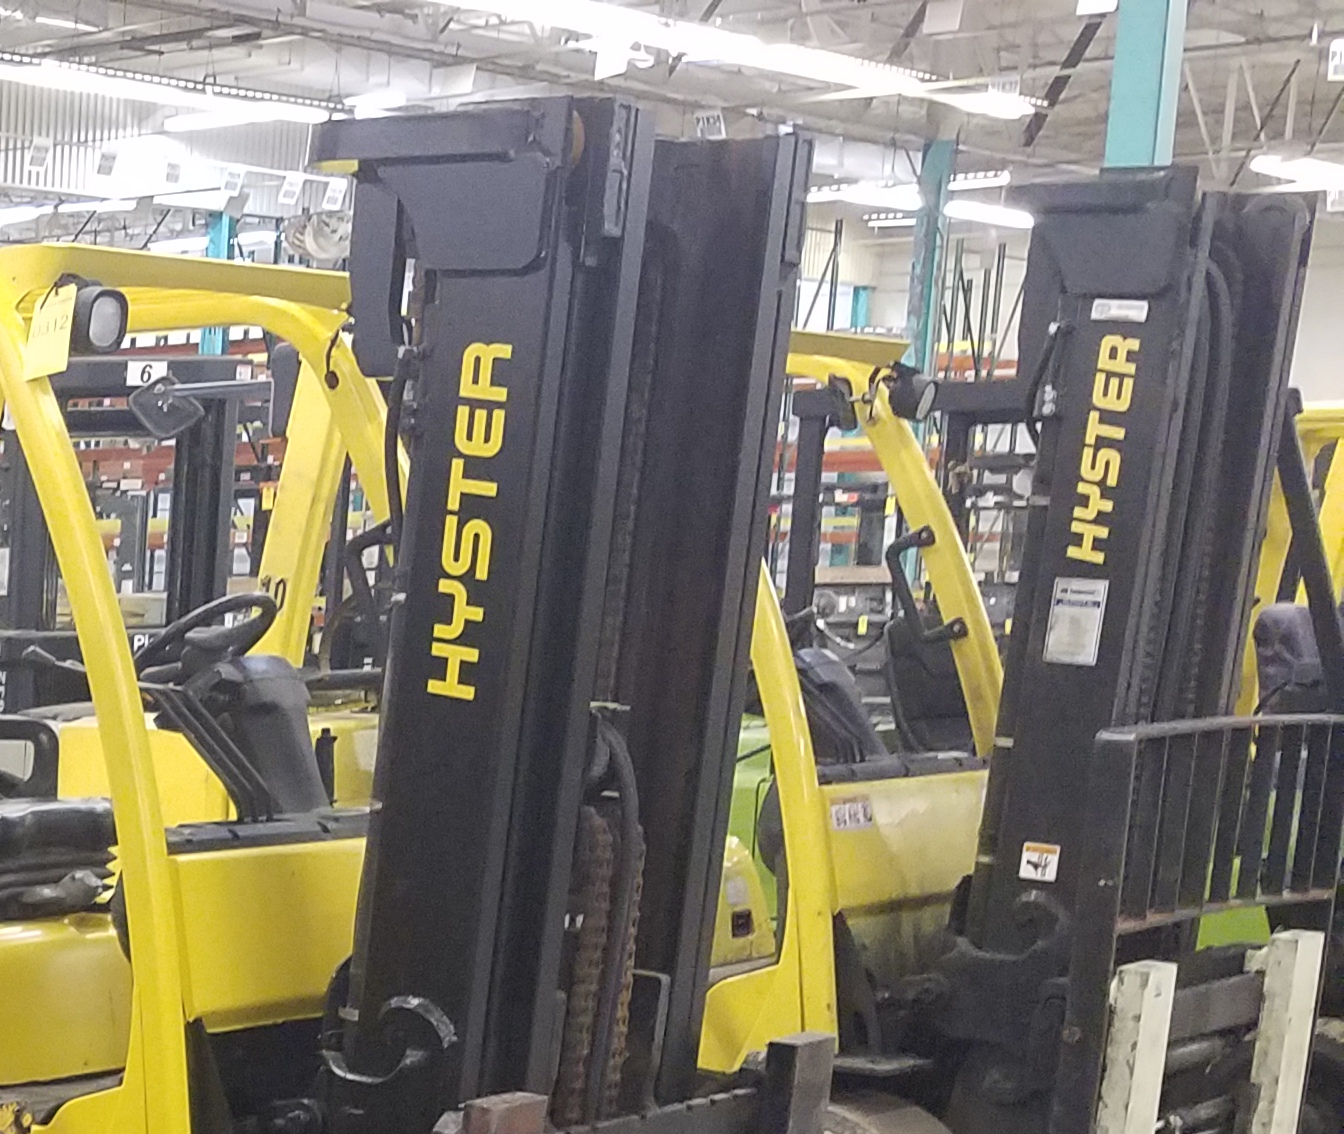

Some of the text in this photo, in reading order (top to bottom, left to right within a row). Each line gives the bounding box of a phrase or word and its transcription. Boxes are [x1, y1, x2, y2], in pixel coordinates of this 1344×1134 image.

[140, 363, 153, 384] 6
[1066, 334, 1141, 564] HYSTER
[426, 341, 514, 701] HYSTER
